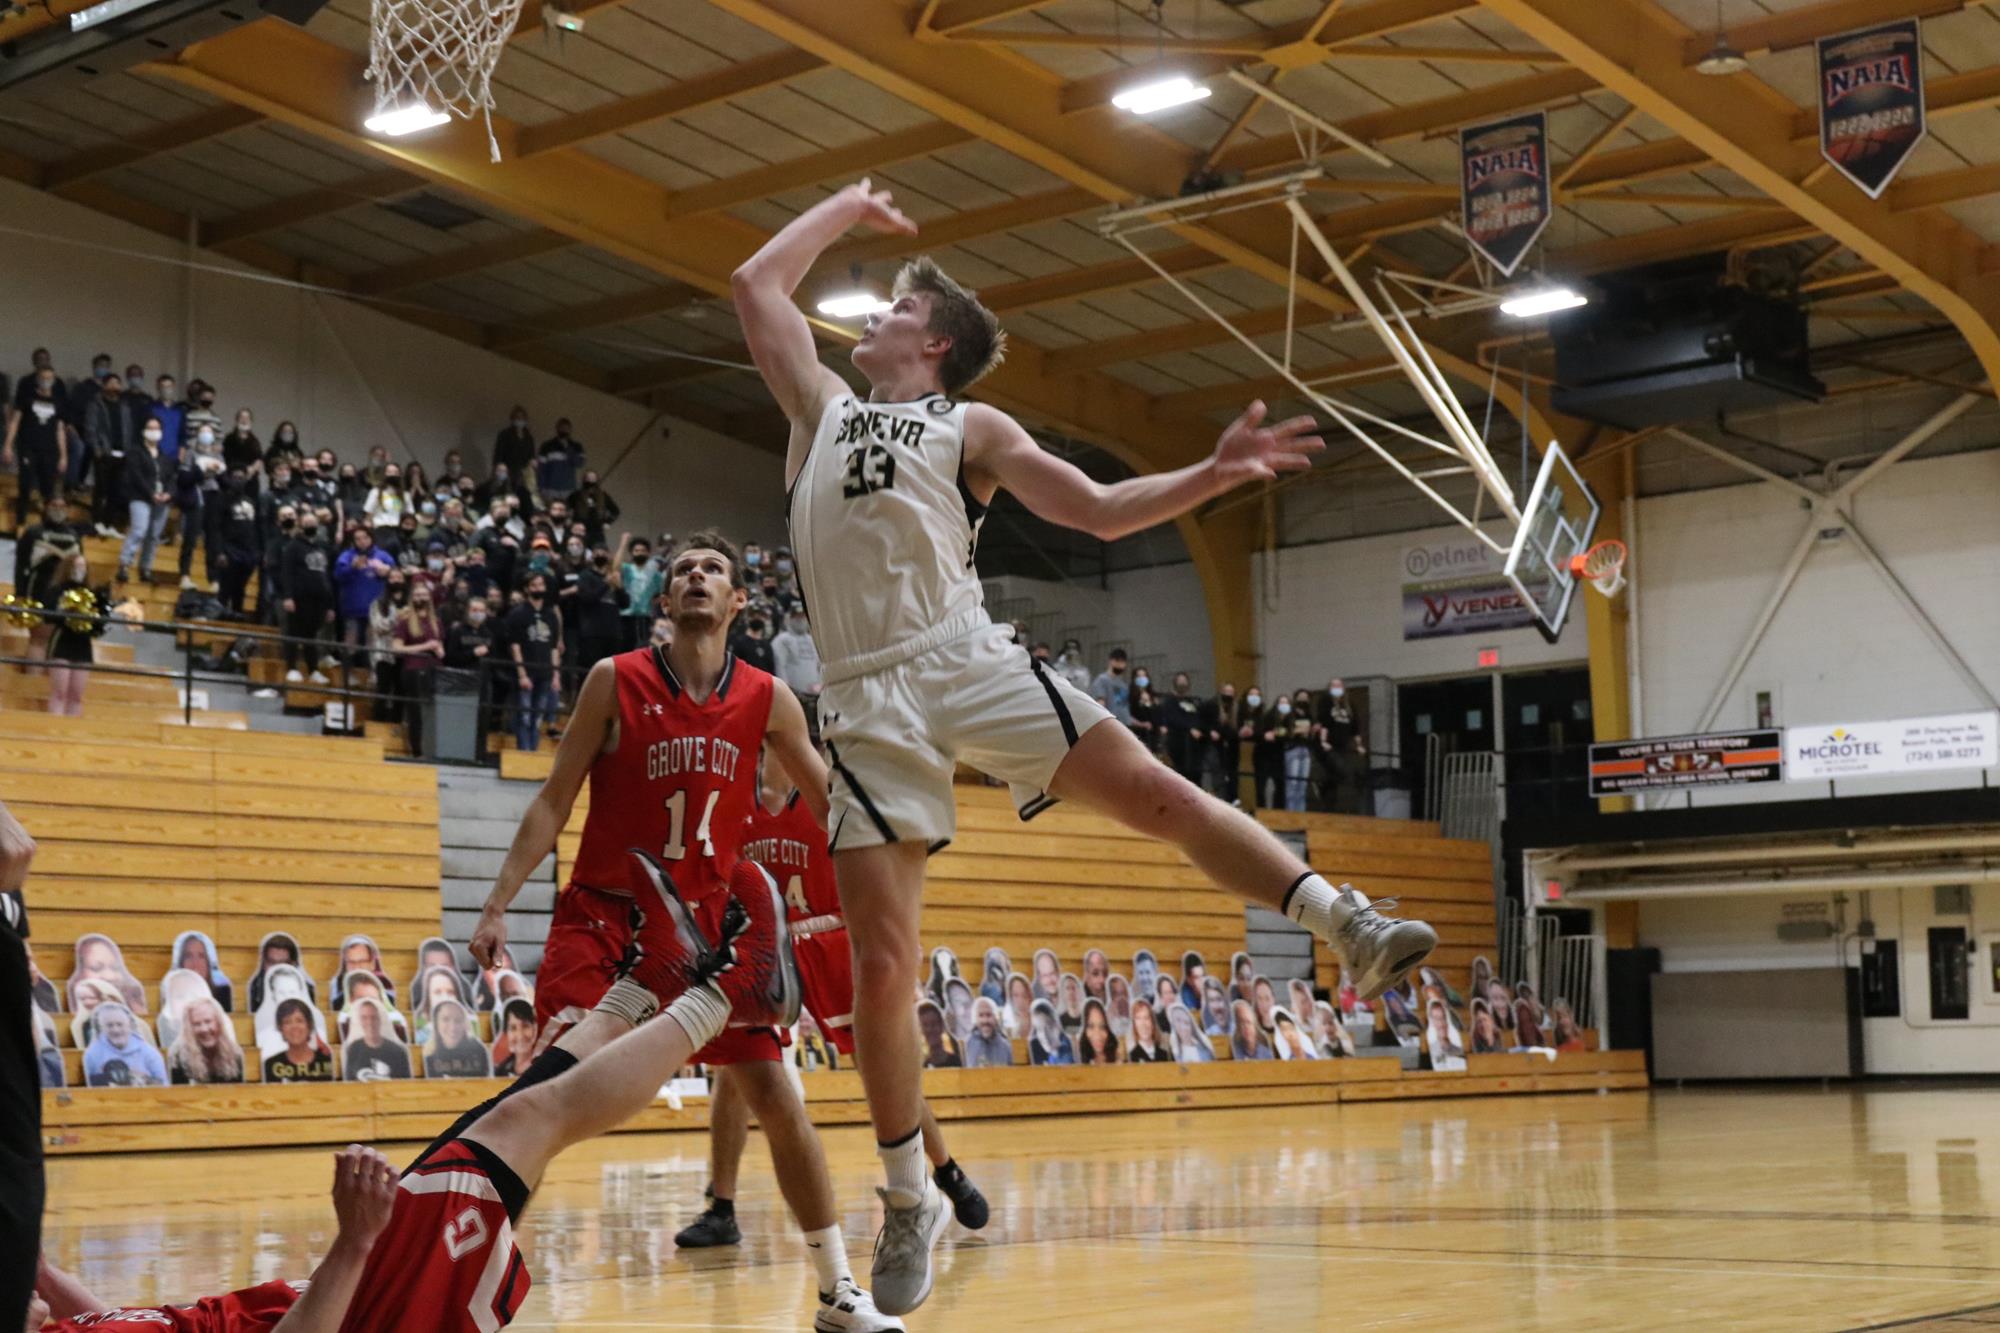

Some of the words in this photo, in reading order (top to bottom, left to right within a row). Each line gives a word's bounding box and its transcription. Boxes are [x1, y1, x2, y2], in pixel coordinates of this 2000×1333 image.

[1829, 57, 1908, 99] NAIA
[1470, 148, 1536, 183] NAIA
[835, 411, 925, 448] GENEVA
[843, 444, 896, 500] 33
[647, 736, 706, 781] GROVE
[711, 738, 740, 782] CITY
[1799, 742, 1882, 760] MICROTEL
[662, 789, 720, 860] 14
[780, 839, 809, 869] CITY
[784, 873, 811, 914] 4
[271, 1062, 295, 1078] Go
